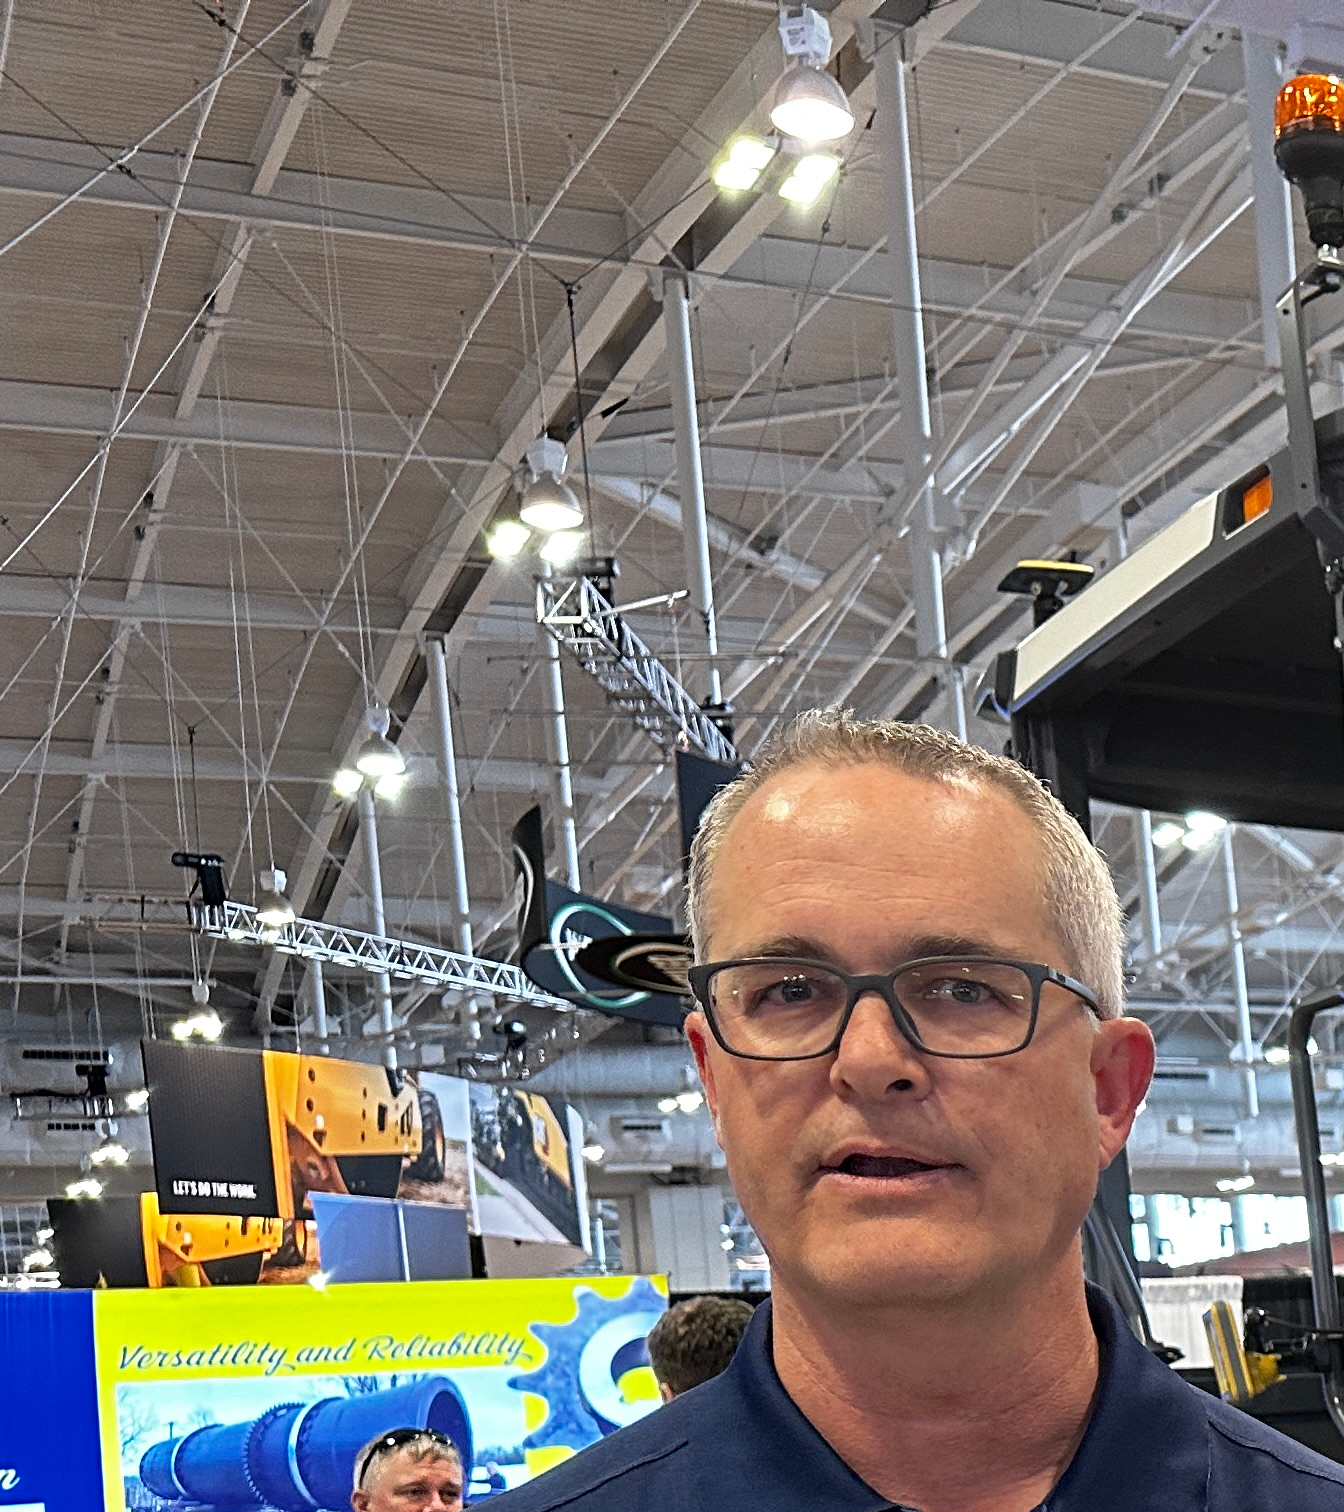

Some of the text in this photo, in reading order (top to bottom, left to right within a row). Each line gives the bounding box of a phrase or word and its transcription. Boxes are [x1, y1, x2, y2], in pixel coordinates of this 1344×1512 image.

[172, 1180, 197, 1196] LET'S
[198, 1181, 211, 1197] DO
[212, 1182, 229, 1198] THE
[118, 1332, 533, 1376] Versatility and Reliability
